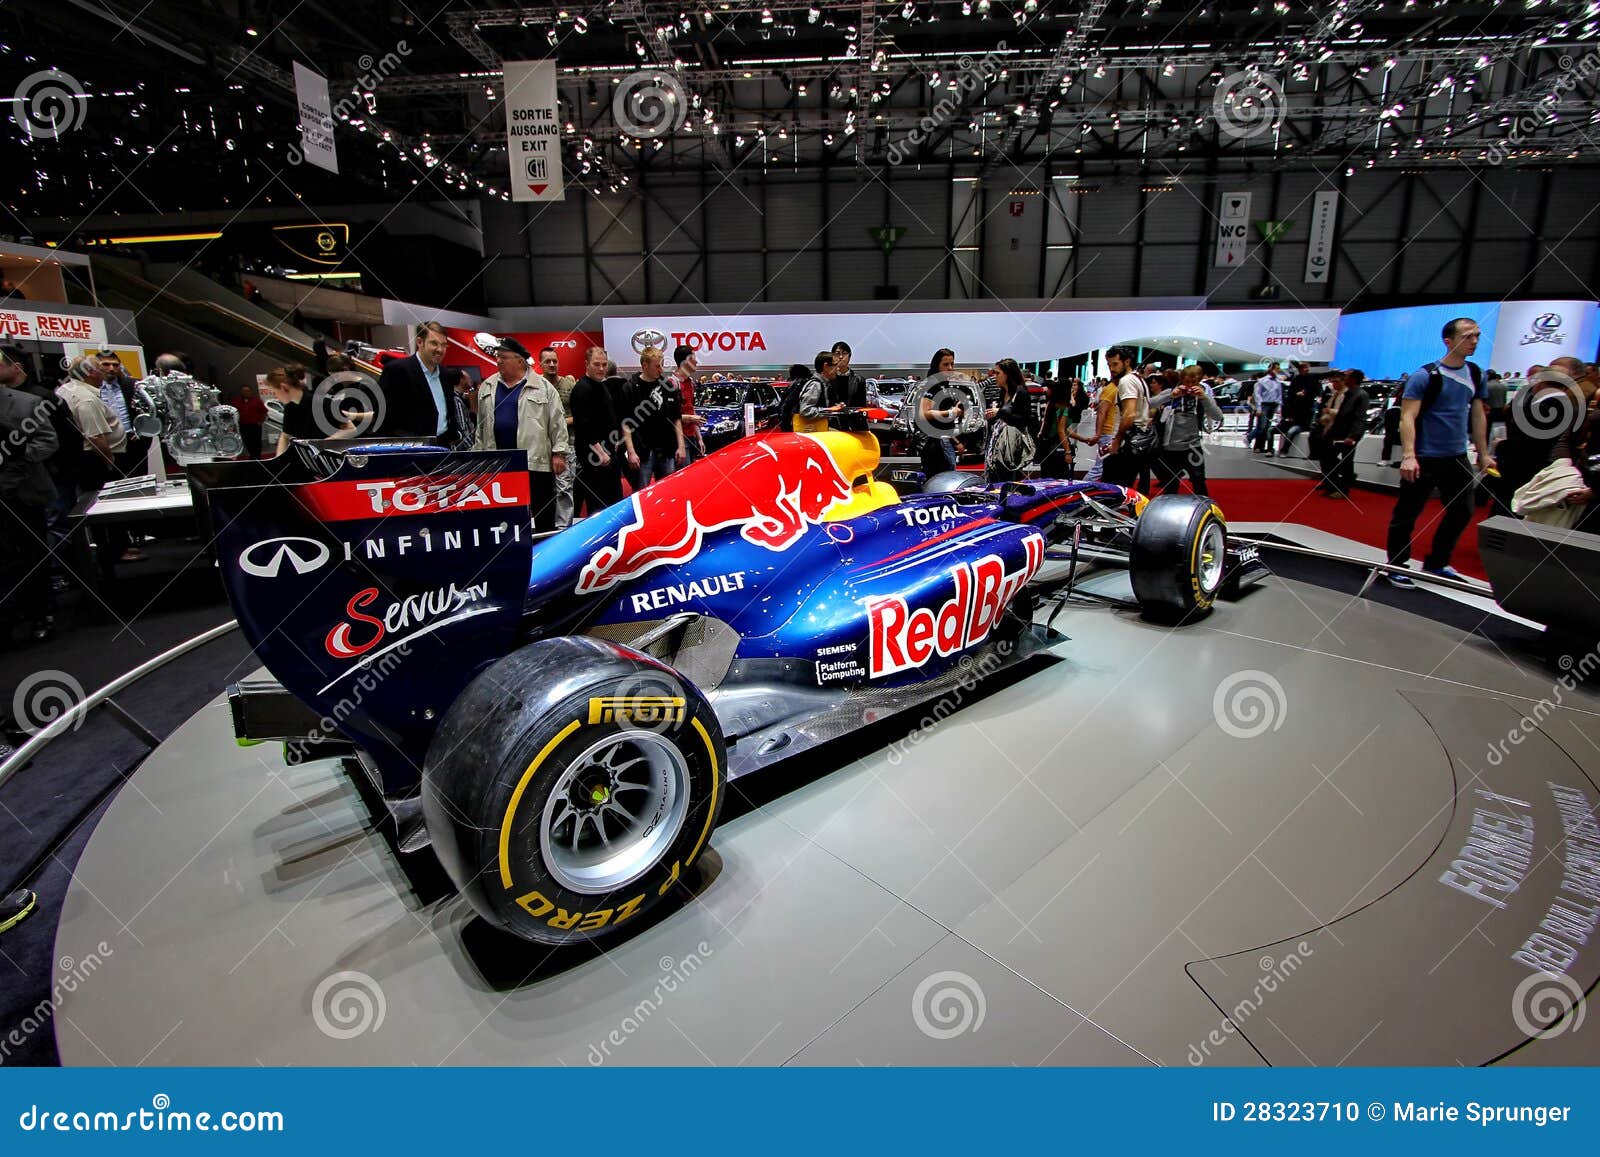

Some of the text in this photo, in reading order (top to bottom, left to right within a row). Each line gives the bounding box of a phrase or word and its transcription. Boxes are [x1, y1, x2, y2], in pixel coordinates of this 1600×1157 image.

[512, 108, 553, 121] SORTIE
[510, 124, 558, 137] AUSGANG
[521, 140, 548, 152] EXIT
[1219, 225, 1246, 238] WC
[36, 315, 92, 333] REVUE
[1267, 325, 1317, 335] ALWAYS A
[40, 330, 90, 340] AUTOMOBILE
[670, 331, 767, 351] TOYOTA
[1266, 336, 1328, 346] BETTER WAY
[356, 480, 518, 514] TOTAL
[895, 503, 969, 527] TOTAL
[343, 524, 521, 561] INFINITI
[630, 571, 746, 614] RENAULT
[816, 642, 857, 657] SIEMENS
[820, 660, 858, 673] Platform
[821, 667, 866, 681] Computing
[588, 696, 686, 725] PIRELLI
[1439, 807, 1535, 910] FORMEL
[514, 860, 680, 932] P ZERO
